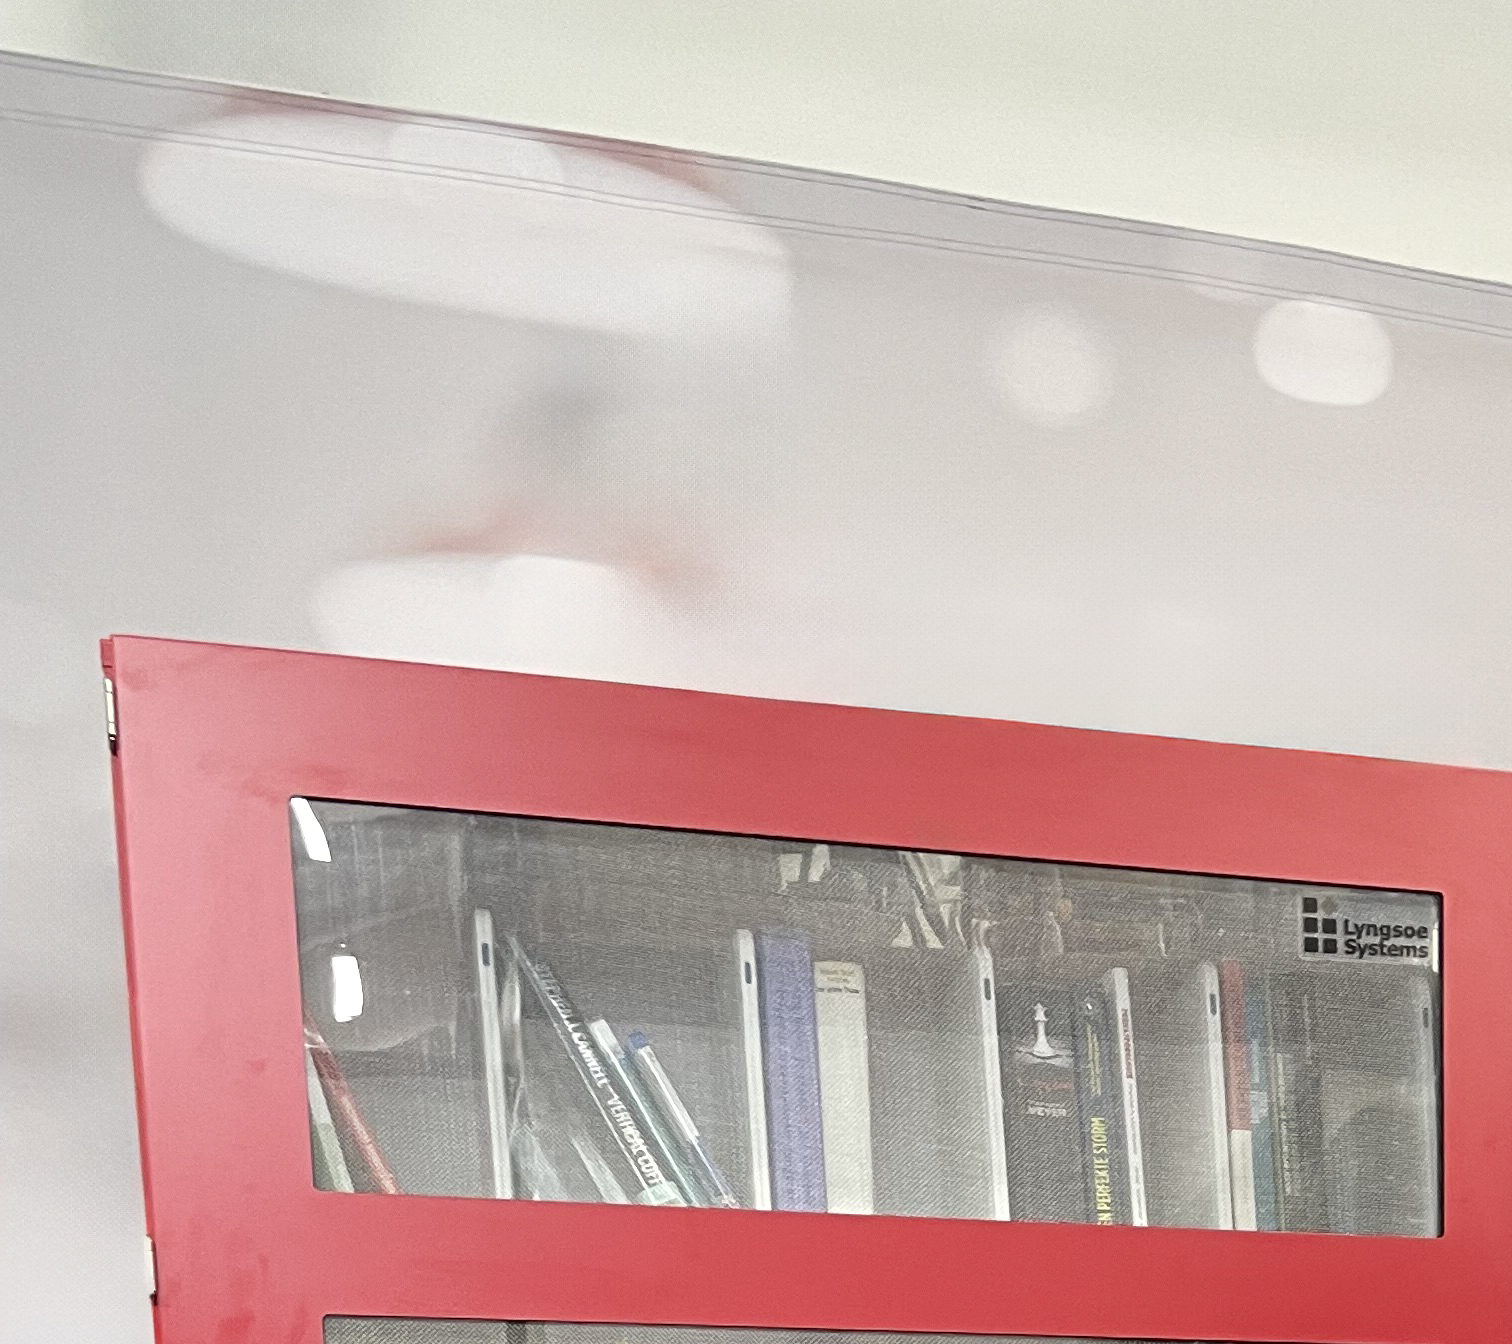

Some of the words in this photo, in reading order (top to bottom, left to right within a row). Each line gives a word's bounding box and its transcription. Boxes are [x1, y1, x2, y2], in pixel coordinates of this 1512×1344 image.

[1344, 918, 1429, 940] Lyngsoe
[1344, 938, 1429, 959] Systems
[1090, 1116, 1106, 1154] STORM
